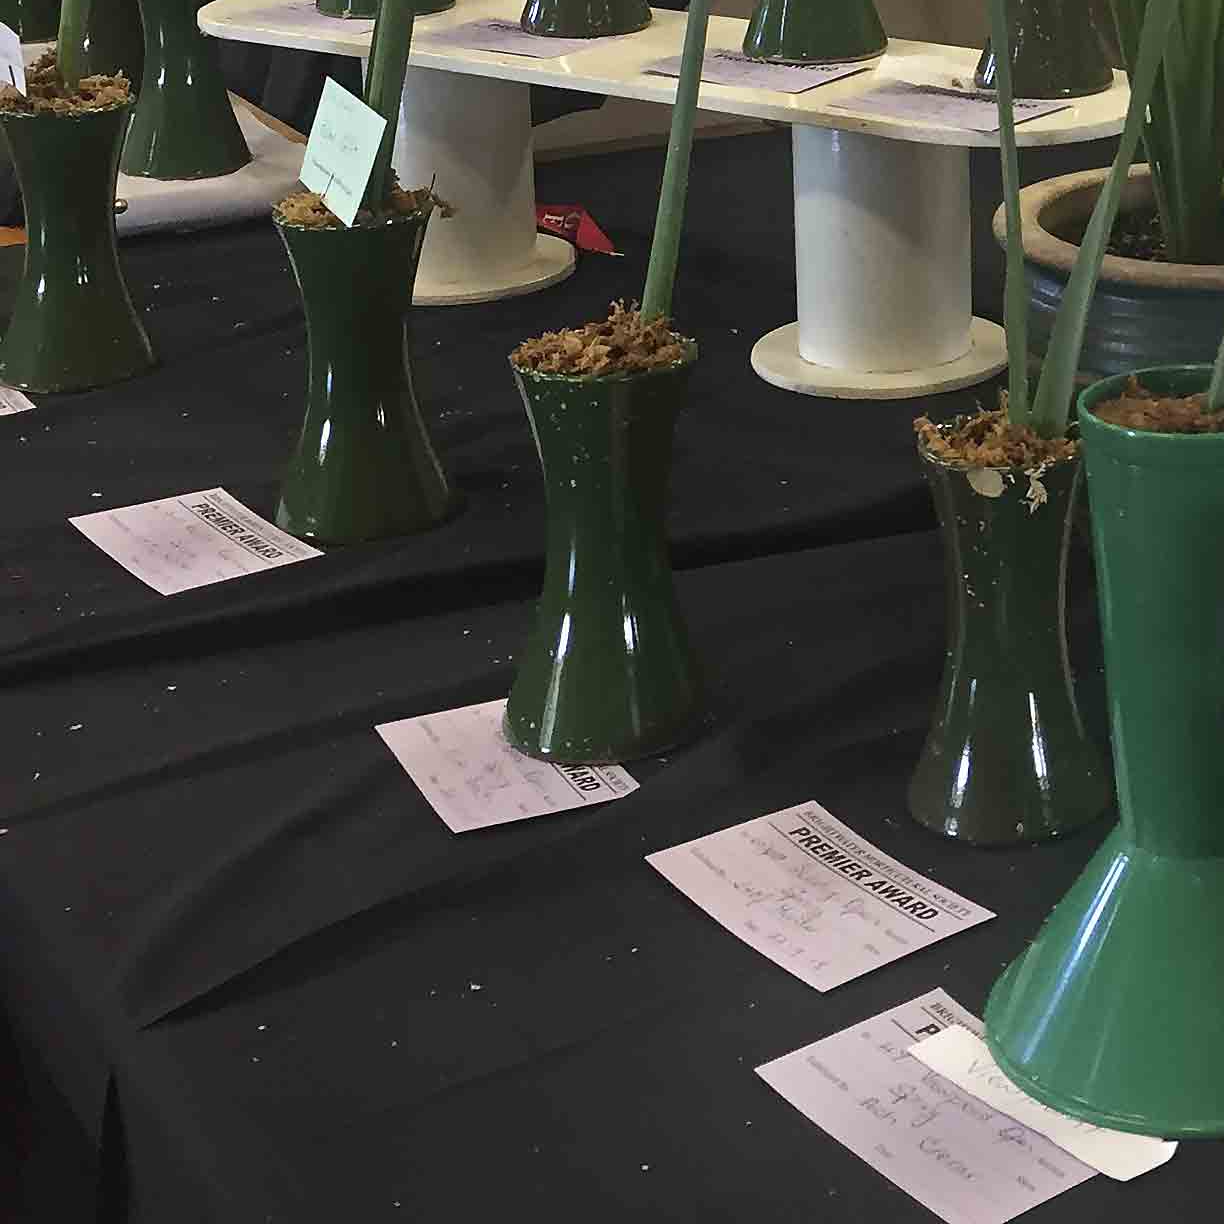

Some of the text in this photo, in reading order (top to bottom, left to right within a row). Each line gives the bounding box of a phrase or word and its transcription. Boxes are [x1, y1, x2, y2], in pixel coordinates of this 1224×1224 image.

[192, 503, 245, 536] PREMIER
[240, 534, 283, 559] AWARD
[789, 827, 873, 881] PREMIER
[864, 879, 939, 920] AWARD
